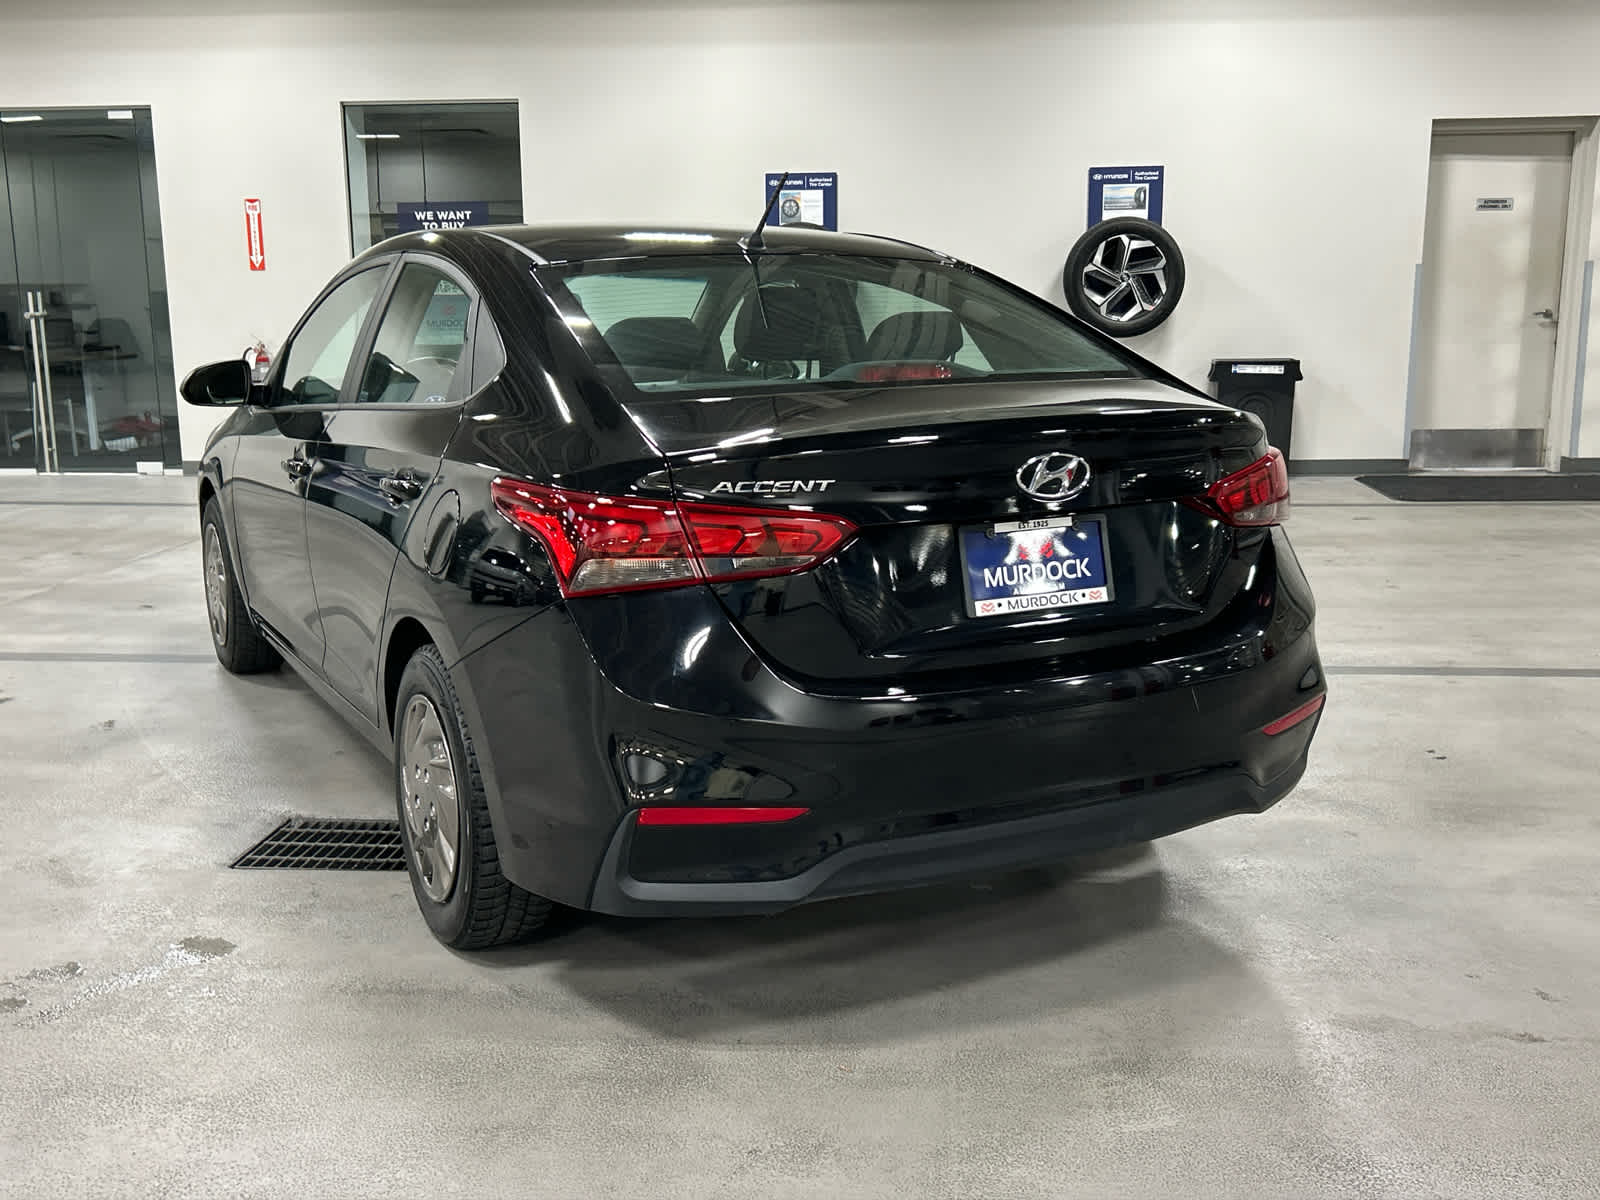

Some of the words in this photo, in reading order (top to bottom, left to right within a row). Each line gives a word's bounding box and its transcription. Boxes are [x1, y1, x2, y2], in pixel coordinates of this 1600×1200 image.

[414, 210, 434, 221] WE
[437, 210, 472, 220] WANT
[422, 221, 438, 230] TO
[440, 221, 465, 230] BUY
[710, 479, 836, 494] ACCENT
[984, 558, 1091, 587] MURDOCK
[1008, 592, 1079, 609] MURDOCK
